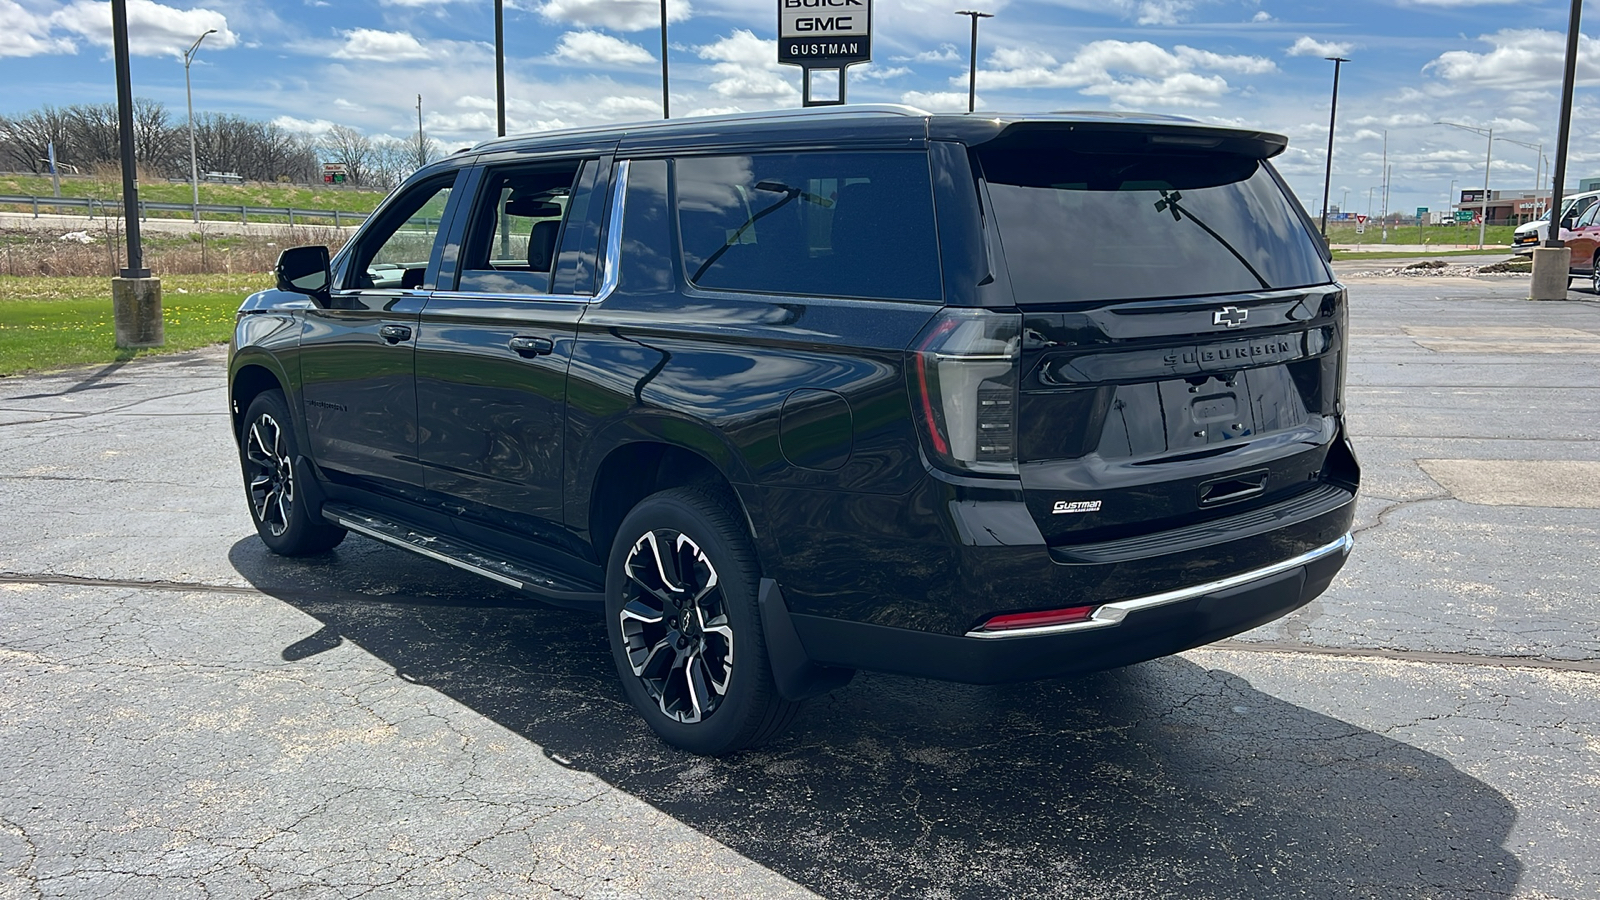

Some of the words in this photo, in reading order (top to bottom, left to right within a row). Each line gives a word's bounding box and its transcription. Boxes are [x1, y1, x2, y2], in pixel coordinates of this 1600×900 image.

[795, 16, 853, 31] GMC
[790, 43, 858, 55] GUSTMAN
[1163, 342, 1290, 366] SUBURBAN
